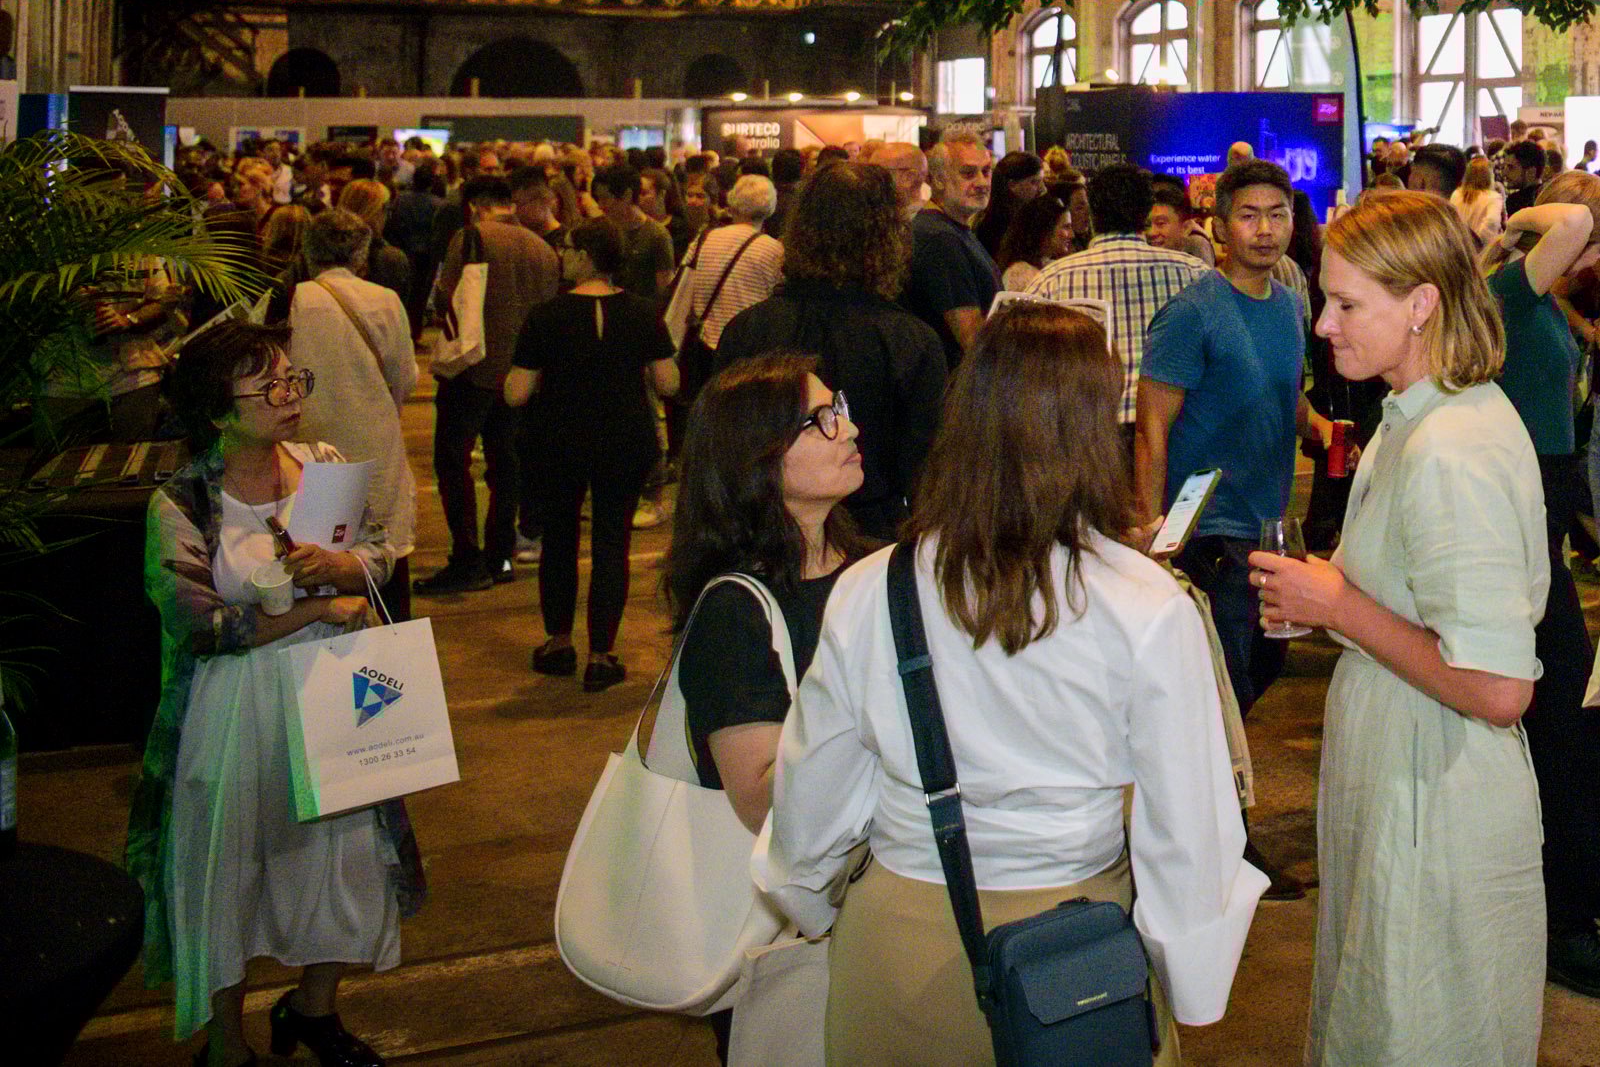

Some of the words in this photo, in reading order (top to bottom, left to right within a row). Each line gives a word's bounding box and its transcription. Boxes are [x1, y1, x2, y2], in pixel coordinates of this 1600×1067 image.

[722, 122, 780, 136] SURTECO
[1065, 133, 1120, 151] ARCHITECTURAL
[1150, 154, 1197, 164] Experience
[1198, 154, 1221, 163] water
[1167, 166, 1174, 174] at
[1176, 166, 1186, 174] its
[1187, 165, 1205, 174] best
[359, 666, 404, 691] AODELI
[346, 734, 424, 756] www.aodeli.com.au
[359, 755, 379, 767] 1300
[381, 753, 391, 762] 26
[393, 750, 404, 759] 33
[406, 747, 416, 756] 54
